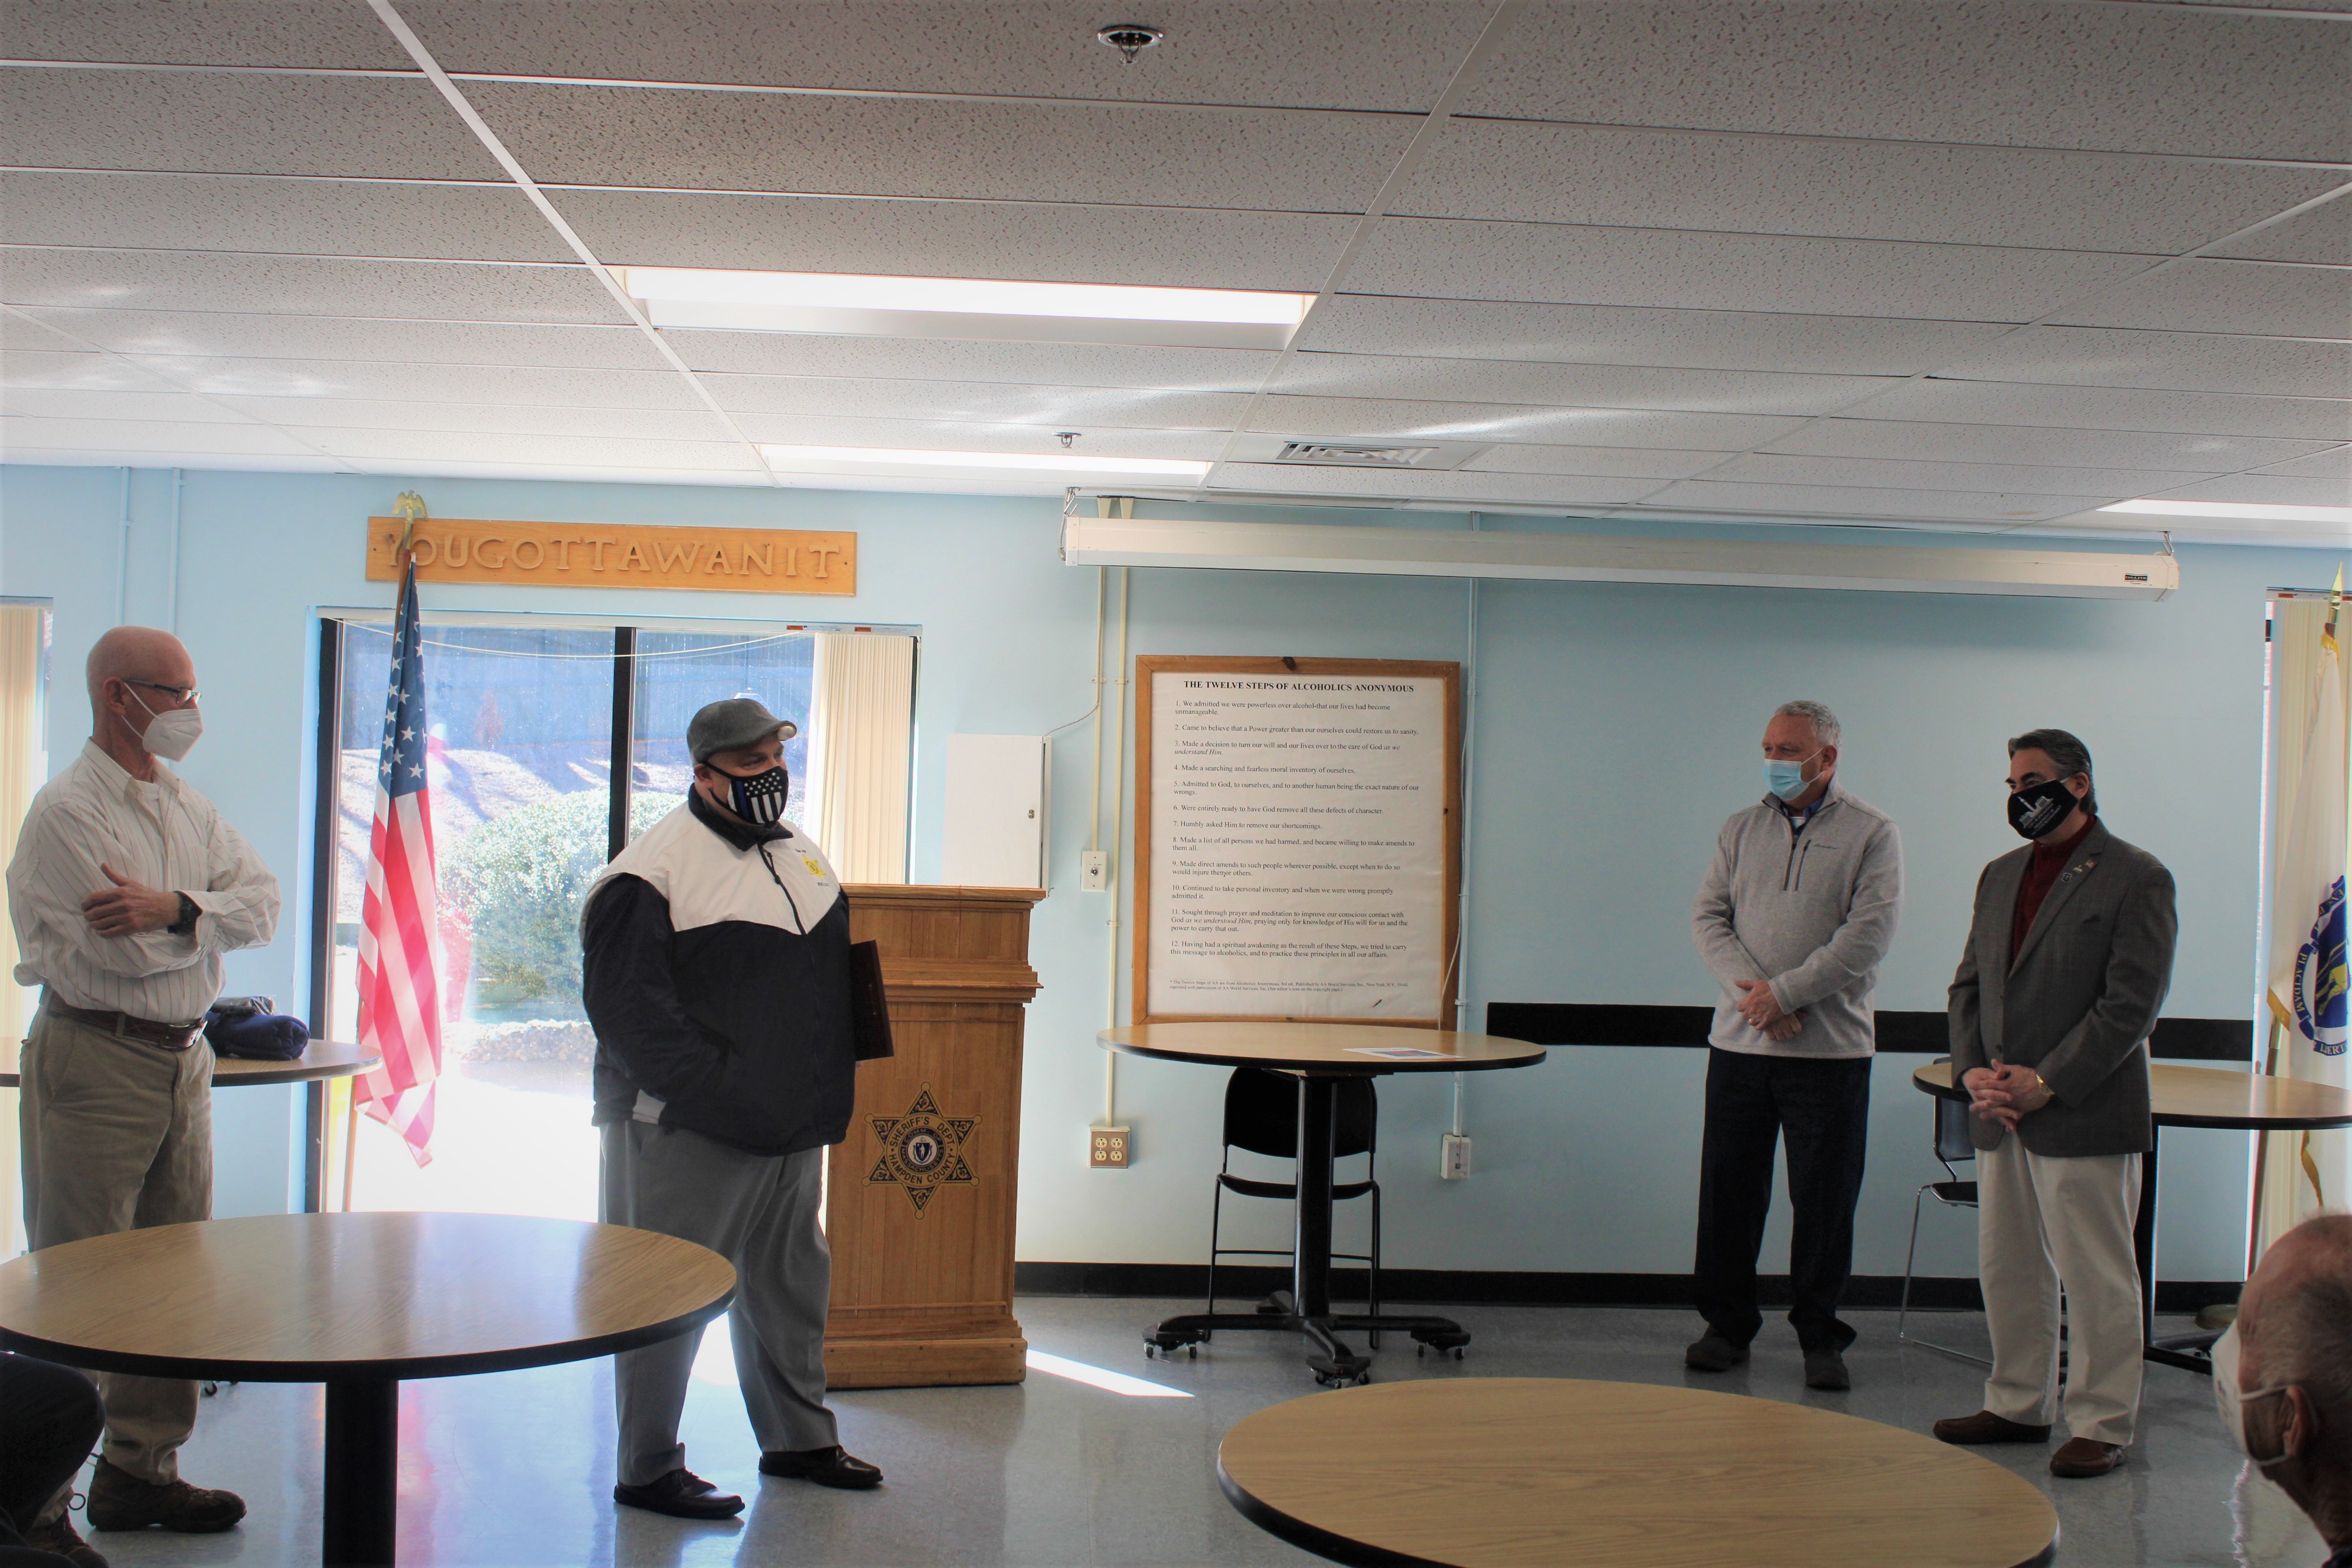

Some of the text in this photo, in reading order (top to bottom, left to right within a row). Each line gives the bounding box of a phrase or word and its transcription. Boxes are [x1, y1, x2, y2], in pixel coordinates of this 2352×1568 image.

[383, 533, 839, 578] YOUGOTTAWANIT
[2294, 952, 2308, 1012] PLACIDAM
[890, 1116, 955, 1148] SHERIFF'S DEPT.
[933, 1133, 941, 1142] OF
[888, 1154, 955, 1184] HAMPDEN COUNTY
[901, 1148, 944, 1171] MASSACHUSETTS
